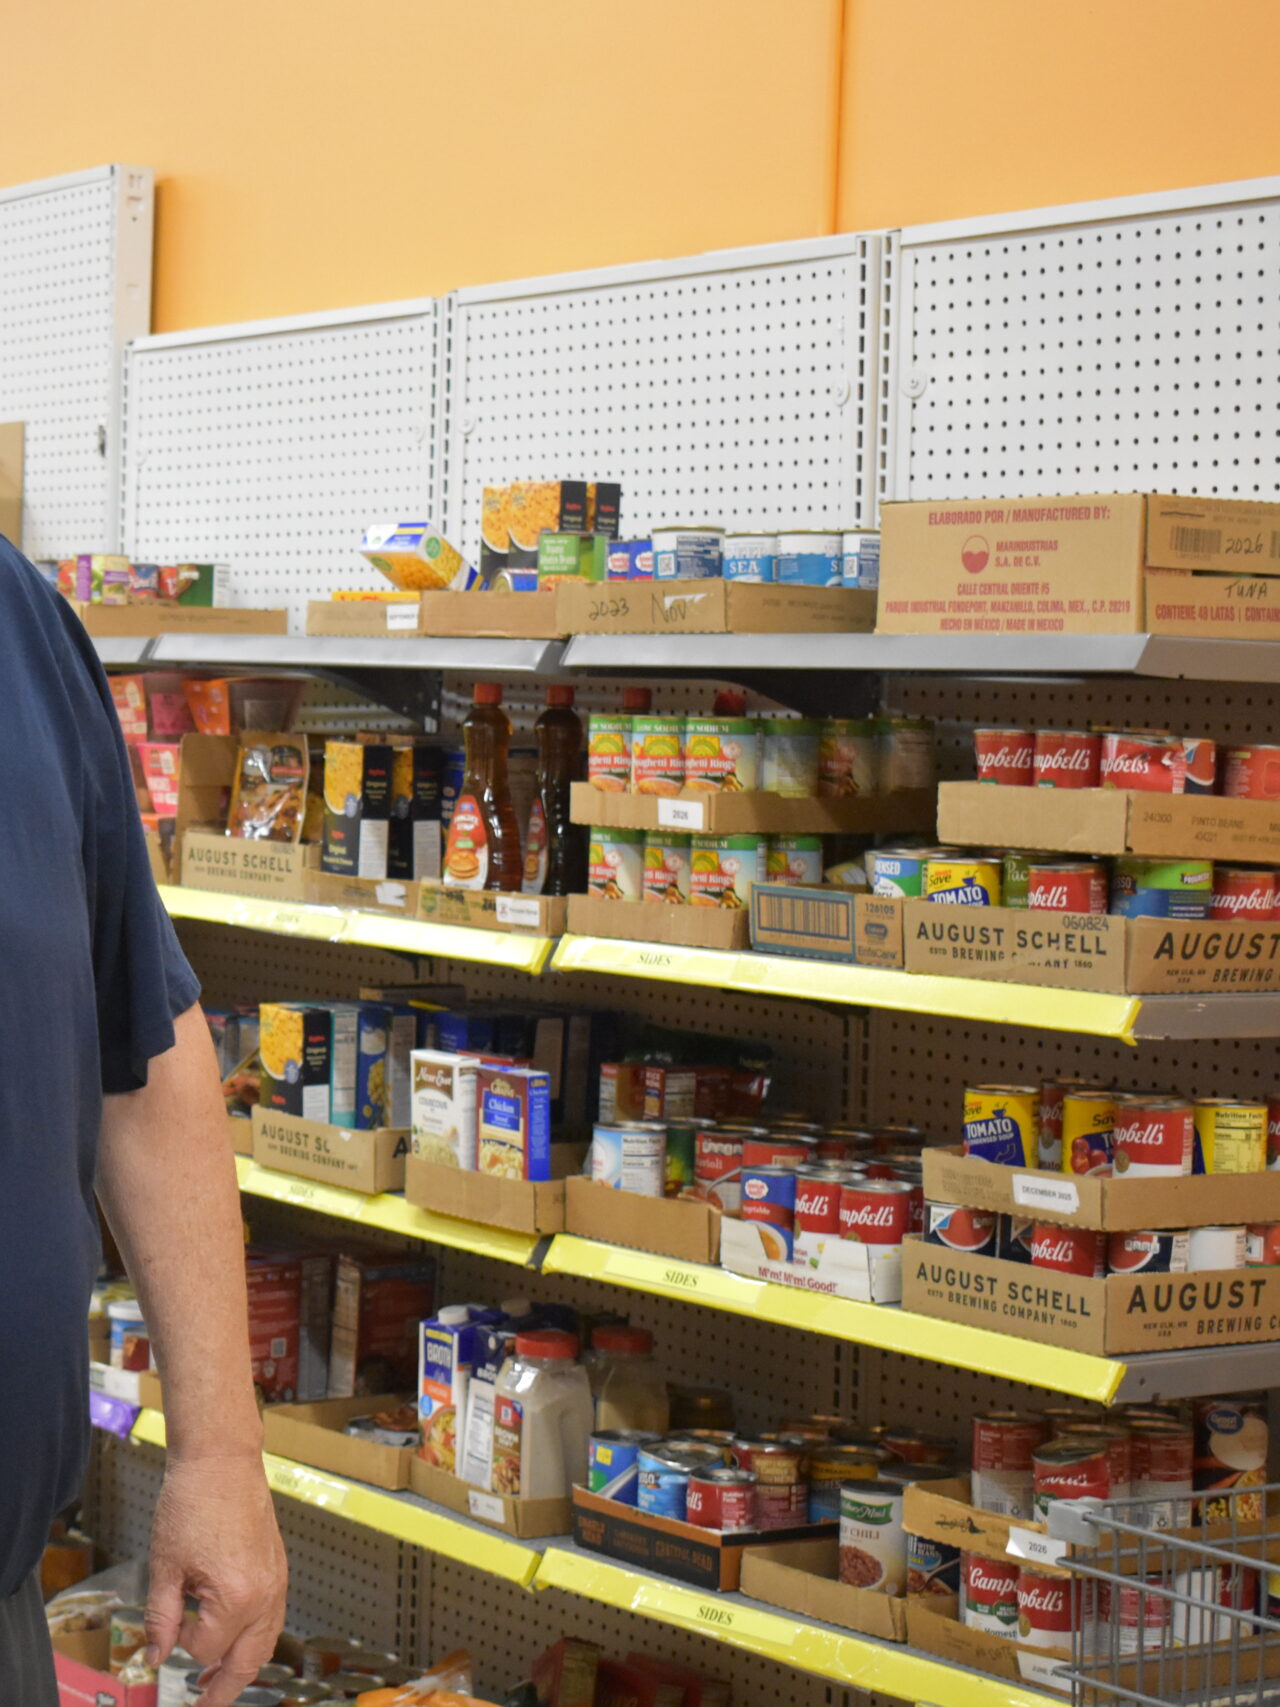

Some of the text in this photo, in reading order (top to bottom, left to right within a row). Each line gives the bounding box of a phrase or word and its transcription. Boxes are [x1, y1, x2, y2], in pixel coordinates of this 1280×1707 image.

[928, 510, 982, 525] ELABORADO
[984, 509, 1004, 524] POR
[1012, 506, 1091, 524] MANUFACTURED
[1093, 506, 1110, 520] BY:
[996, 540, 1058, 552] MARINDUSTRIAS
[1225, 533, 1263, 554] 2026
[729, 560, 760, 574] SEA
[996, 556, 1040, 567] S.A. DE C.V.
[958, 584, 978, 596] CALLE
[979, 584, 1008, 596] CENTRAL
[1010, 583, 1040, 595] ORIENTE
[1224, 581, 1268, 600] TUNA
[589, 590, 686, 624] 2023 Nov
[910, 601, 946, 614] INDUSTRIAL
[1155, 604, 1196, 620] CONTIENE
[1210, 606, 1235, 622] LATAS
[940, 618, 961, 632] HECHO
[963, 618, 973, 632] EN
[1006, 618, 1026, 632] MADE
[1028, 618, 1035, 631] IN
[1036, 618, 1064, 632] MEXICO
[590, 755, 612, 767] ghetti
[710, 760, 736, 770] Rings
[978, 746, 1032, 772] mpbell's
[1034, 748, 1090, 772] mpbell's
[188, 847, 292, 873] AUGUST SCHELL
[877, 860, 900, 876] ENSED
[932, 886, 982, 904] TOMATO
[1028, 884, 1068, 910] pbell's
[916, 922, 1004, 946] AUGUST
[1016, 930, 1106, 956] SCHELL
[1153, 932, 1280, 960] AUGUST
[638, 952, 671, 966] SIDES
[1212, 968, 1273, 982] BREWING
[966, 1118, 1012, 1139] TOMATO
[1092, 1114, 1116, 1127] Sav
[261, 1123, 310, 1148] AUGUST
[1113, 1122, 1164, 1145] mpbell's
[312, 1152, 346, 1170] COMPANY
[1022, 1186, 1057, 1198] DECEMBER
[839, 1205, 894, 1227] mpbell's
[1031, 1238, 1072, 1262] pbell's
[665, 1270, 698, 1288] SIDES
[916, 1262, 1091, 1317] AUGUST SCHELL
[1126, 1279, 1267, 1314] AUGUST
[948, 1292, 998, 1312] BREWING
[1002, 1303, 1056, 1325] COMPANY
[1197, 1316, 1262, 1334] BREWING
[427, 1342, 451, 1367] BROTH
[850, 1527, 880, 1540] CHILI
[1028, 1542, 1047, 1554] 2026
[697, 1606, 733, 1626] SIDES
[984, 1627, 1017, 1639] Homest
